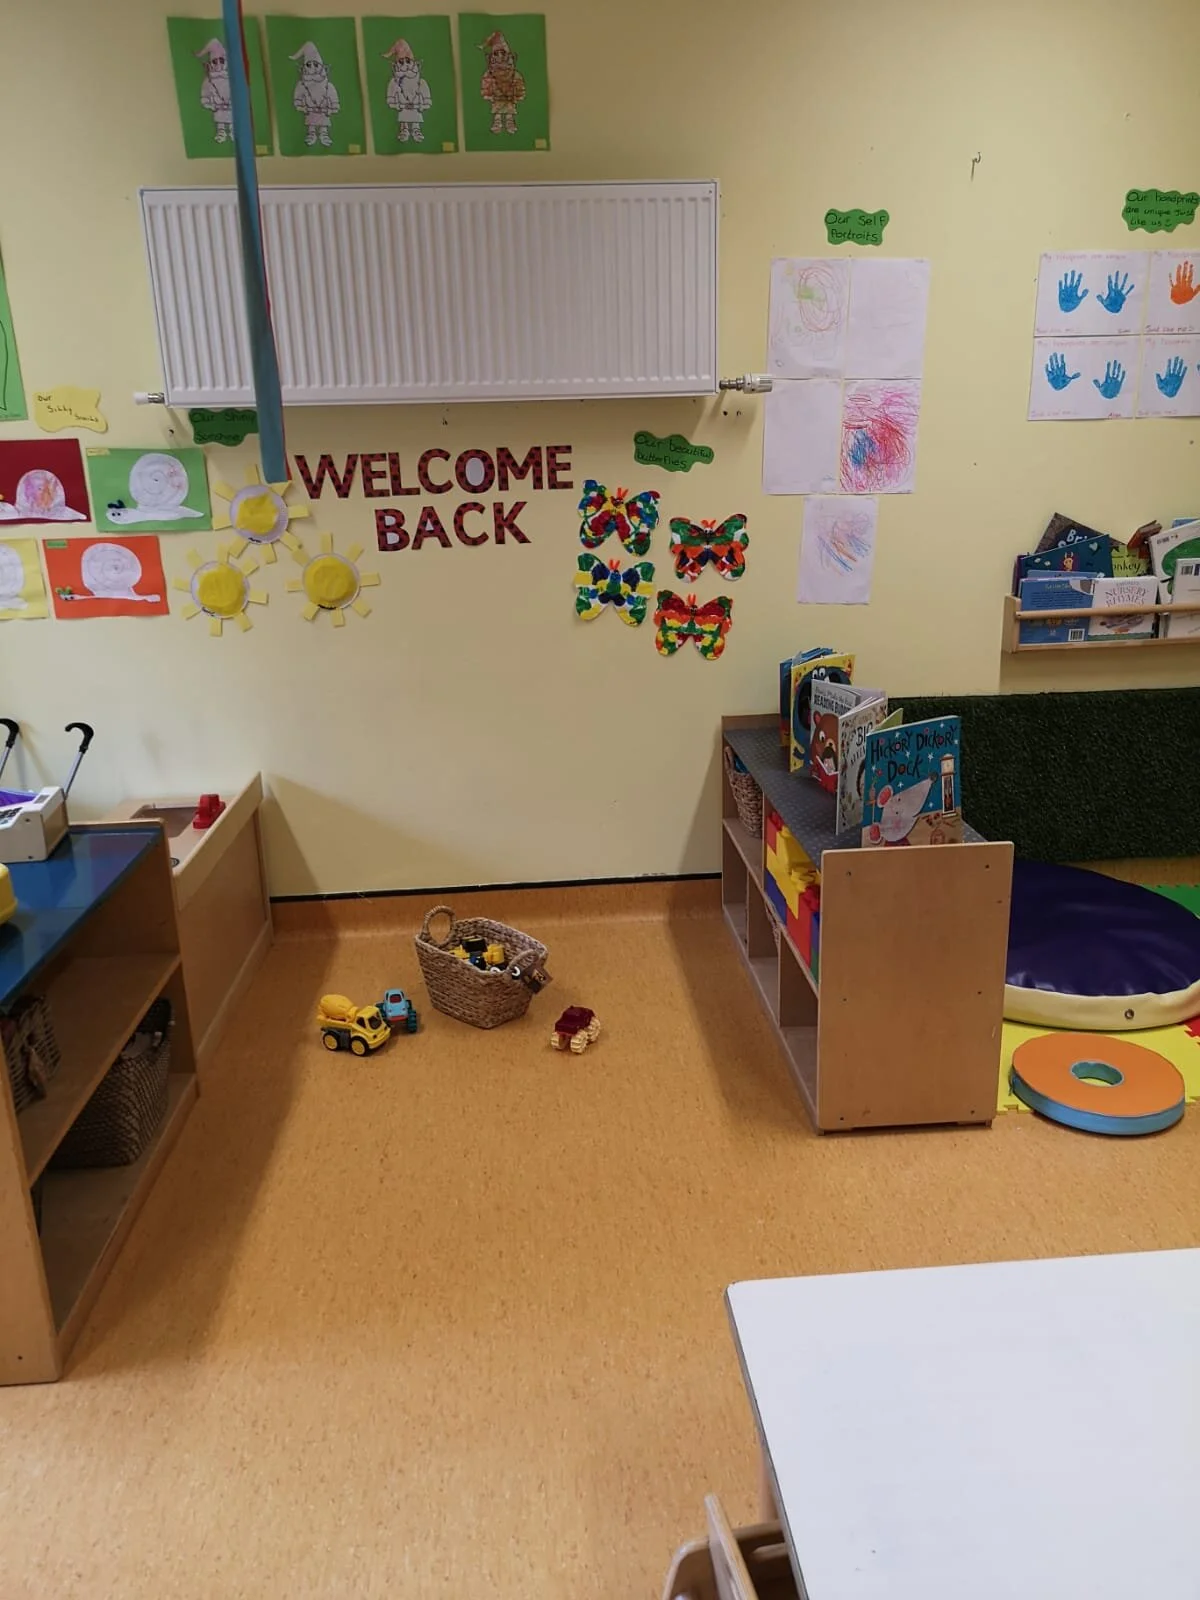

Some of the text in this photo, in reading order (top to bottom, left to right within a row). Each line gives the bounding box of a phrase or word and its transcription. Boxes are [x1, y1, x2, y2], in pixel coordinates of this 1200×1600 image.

[1127, 191, 1147, 202] Our
[825, 212, 887, 227] Our Self
[831, 228, 878, 242] Portraits
[191, 412, 215, 423] Our
[635, 434, 712, 458] Our beautiful
[637, 448, 687, 469] butterflies
[294, 445, 574, 500] WELCOME
[374, 501, 532, 552] BACK
[1104, 586, 1150, 600] NURSERY
[1105, 595, 1146, 608] RHYMES
